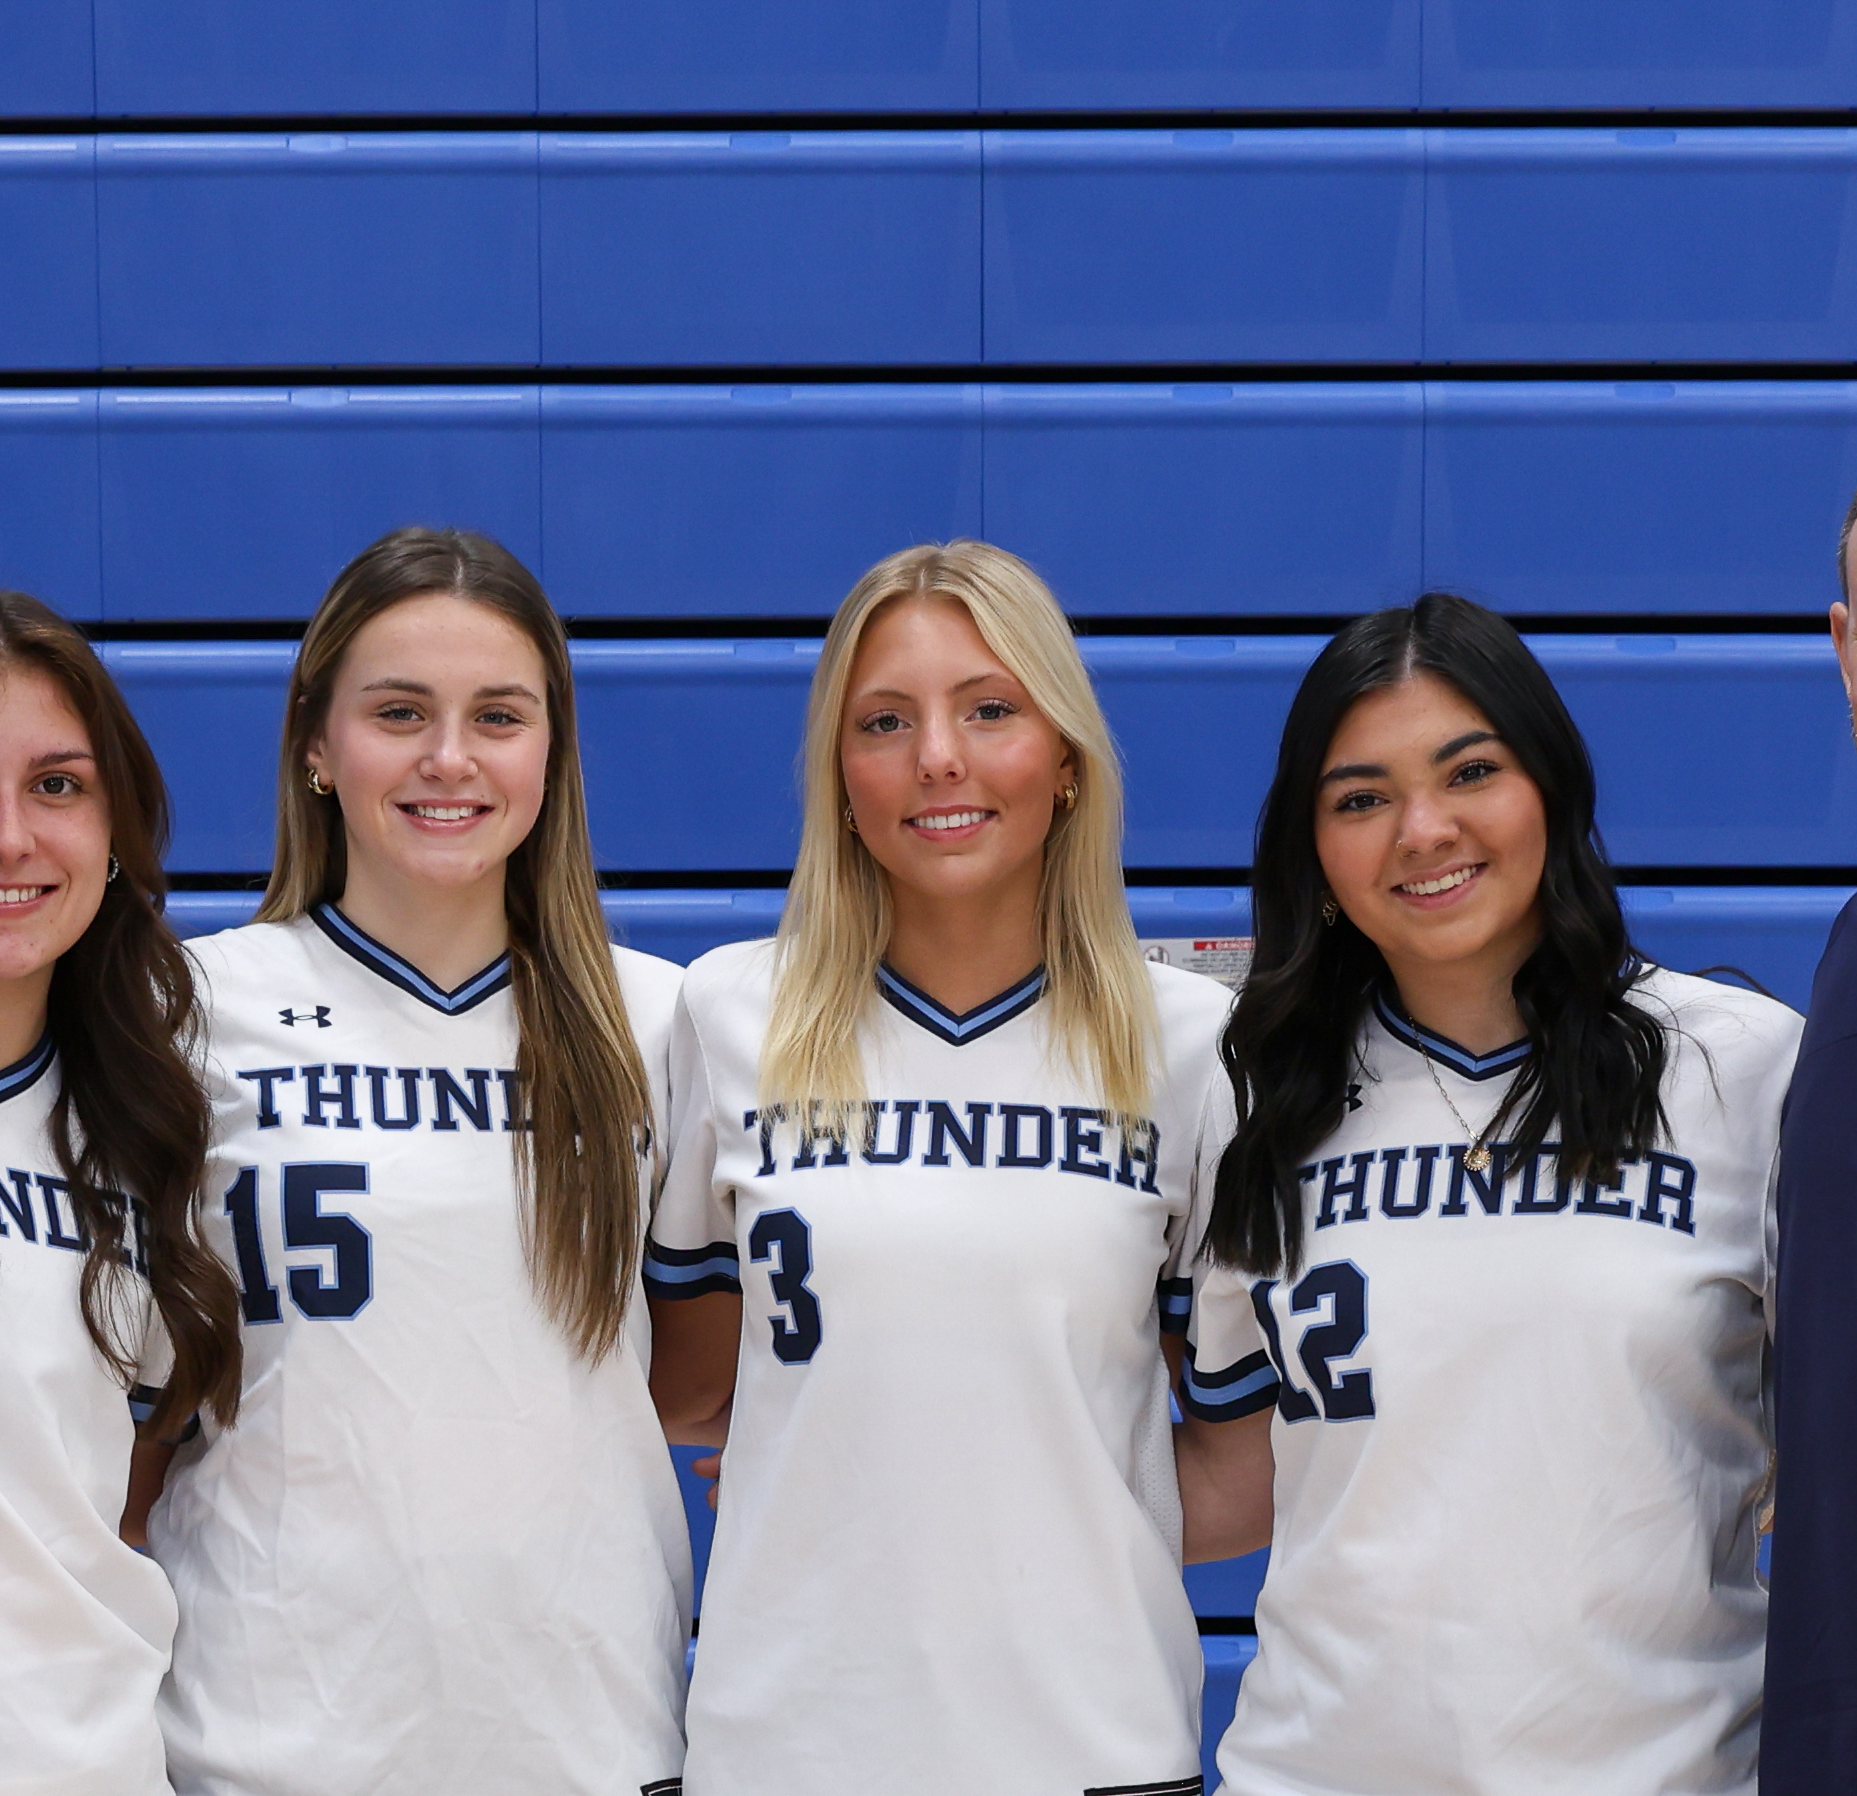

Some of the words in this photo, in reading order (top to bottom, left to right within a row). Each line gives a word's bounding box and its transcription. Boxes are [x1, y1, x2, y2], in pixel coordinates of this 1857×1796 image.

[236, 1063, 541, 1132] THUN
[743, 1099, 1163, 1198] THUNDER
[223, 1161, 374, 1326] 15
[748, 1206, 823, 1366] 3
[1250, 1258, 1376, 1425] 12
